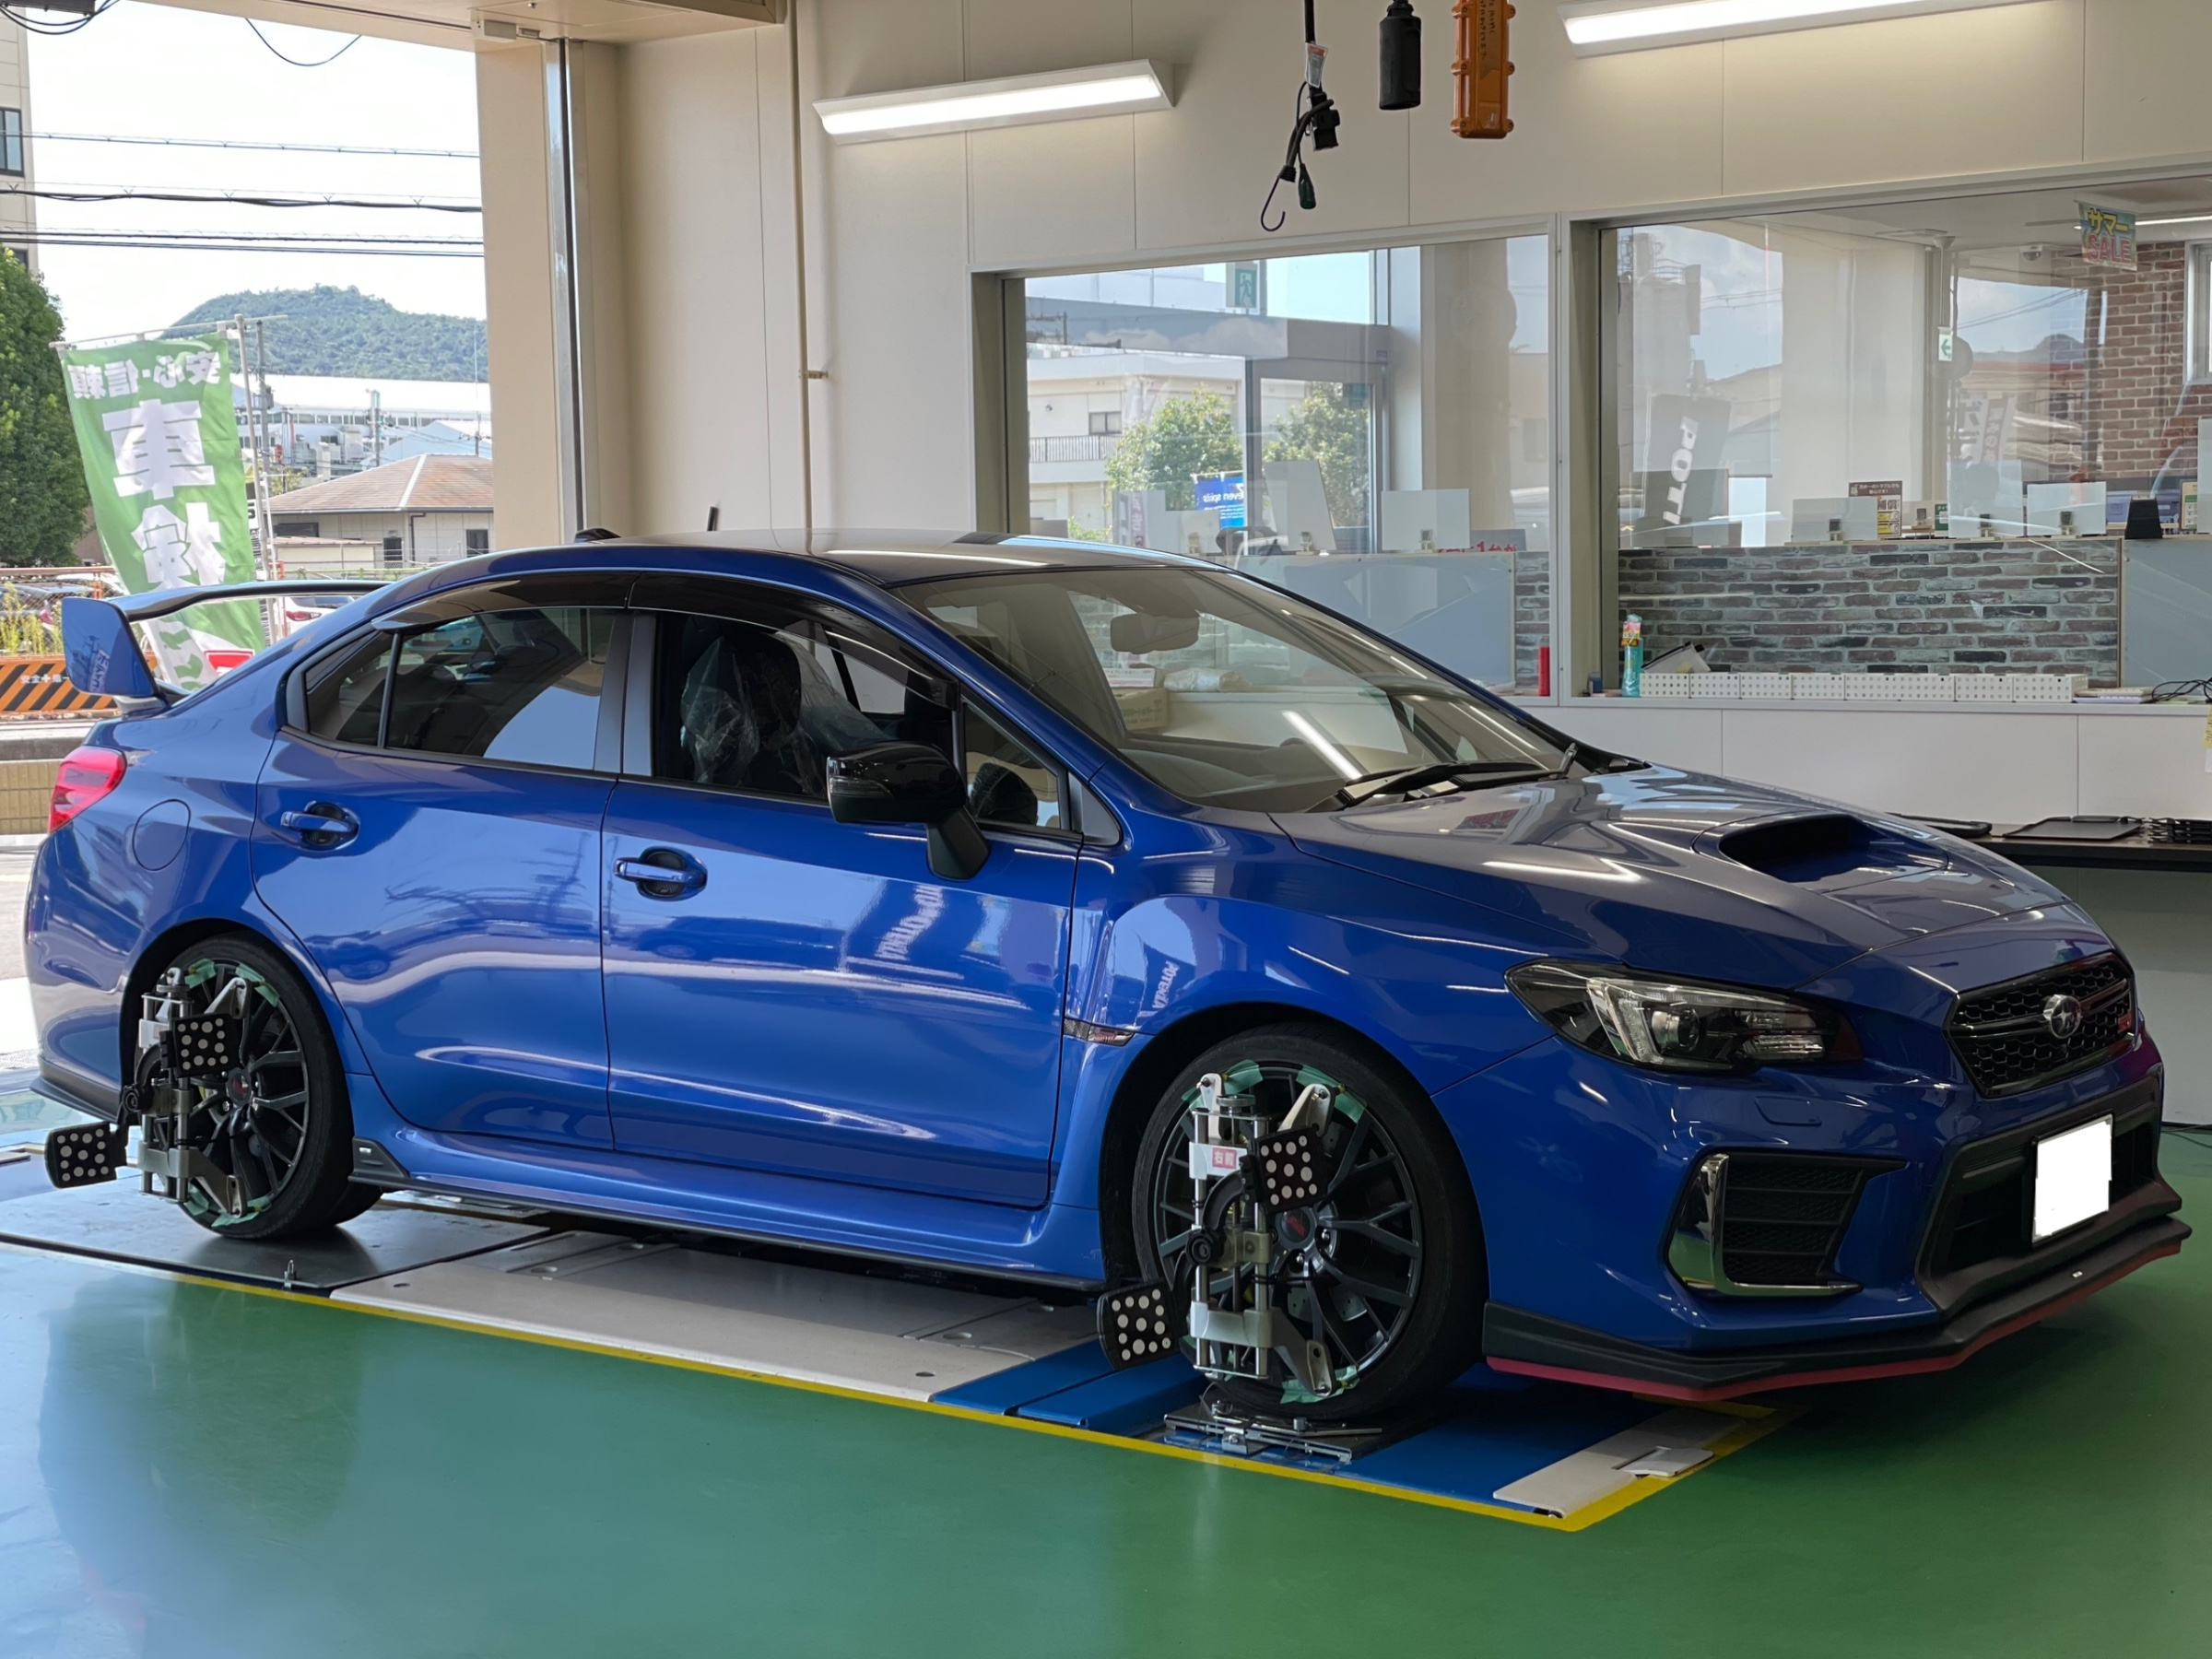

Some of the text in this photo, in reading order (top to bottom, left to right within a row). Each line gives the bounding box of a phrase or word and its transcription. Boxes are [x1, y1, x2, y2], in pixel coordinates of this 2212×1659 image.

[2088, 207, 2129, 237] サマー
[2088, 233, 2131, 264] SALE
